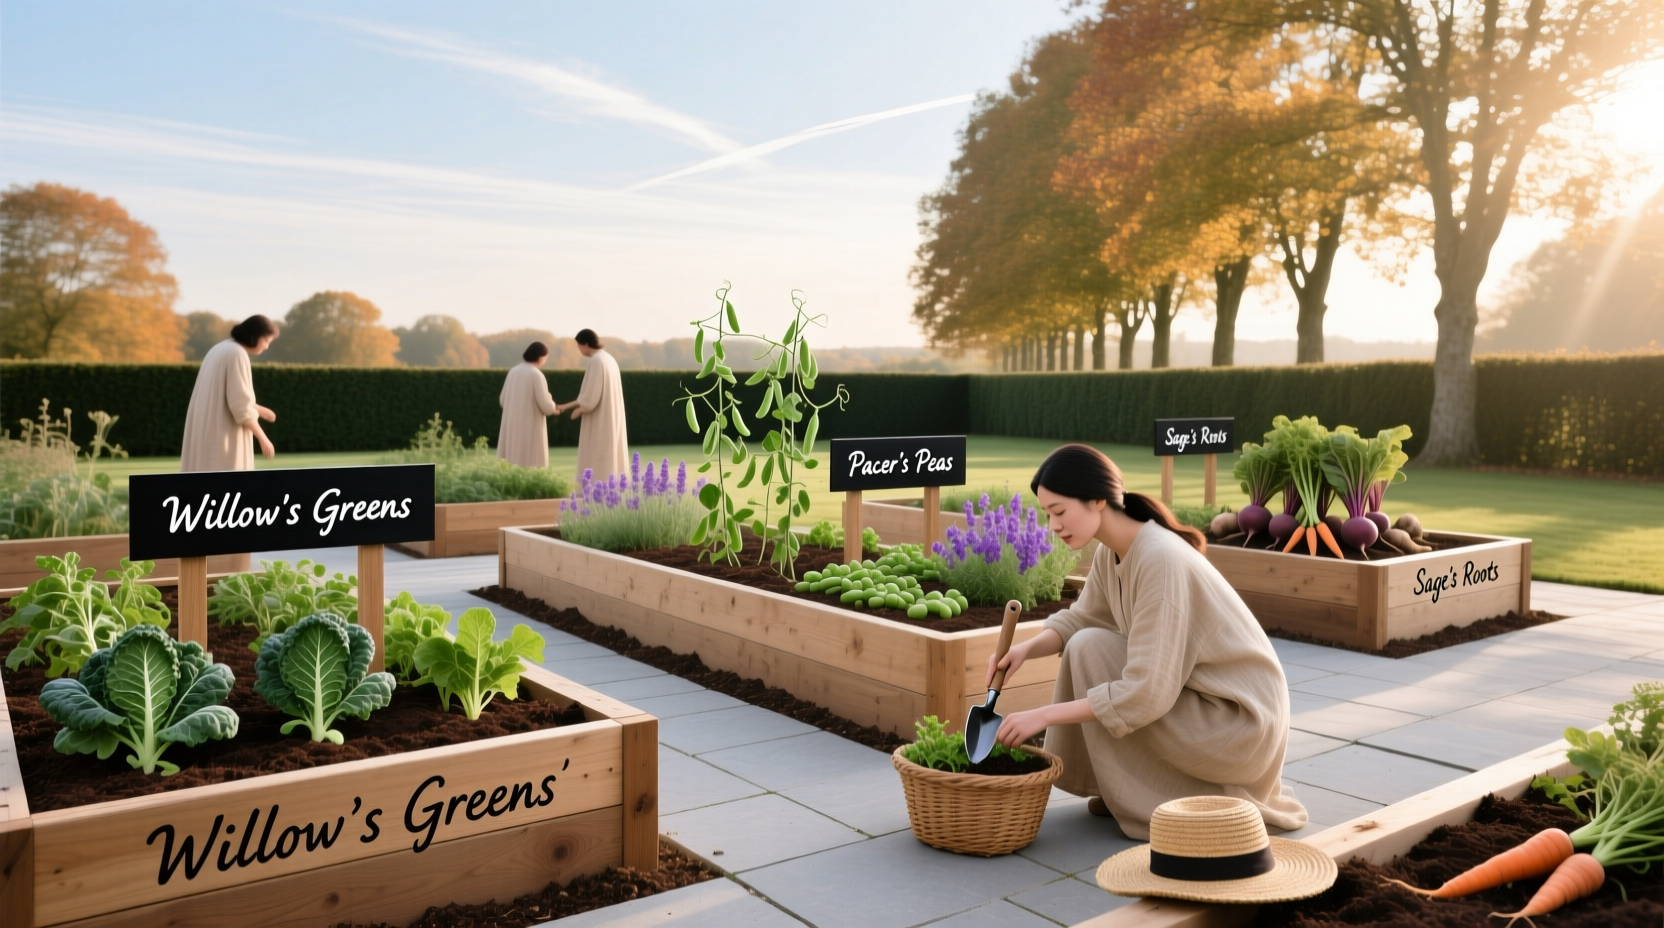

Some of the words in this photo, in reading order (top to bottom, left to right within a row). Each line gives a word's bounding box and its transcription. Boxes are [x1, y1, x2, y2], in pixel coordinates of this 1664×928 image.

[848, 450, 909, 477] Pacer's
[915, 448, 953, 474] Peas
[162, 492, 301, 533] Willow's
[313, 488, 412, 537] Greens
[1413, 566, 1457, 604] Sage's
[1462, 560, 1499, 586] Roots
[146, 797, 383, 886] Willow's
